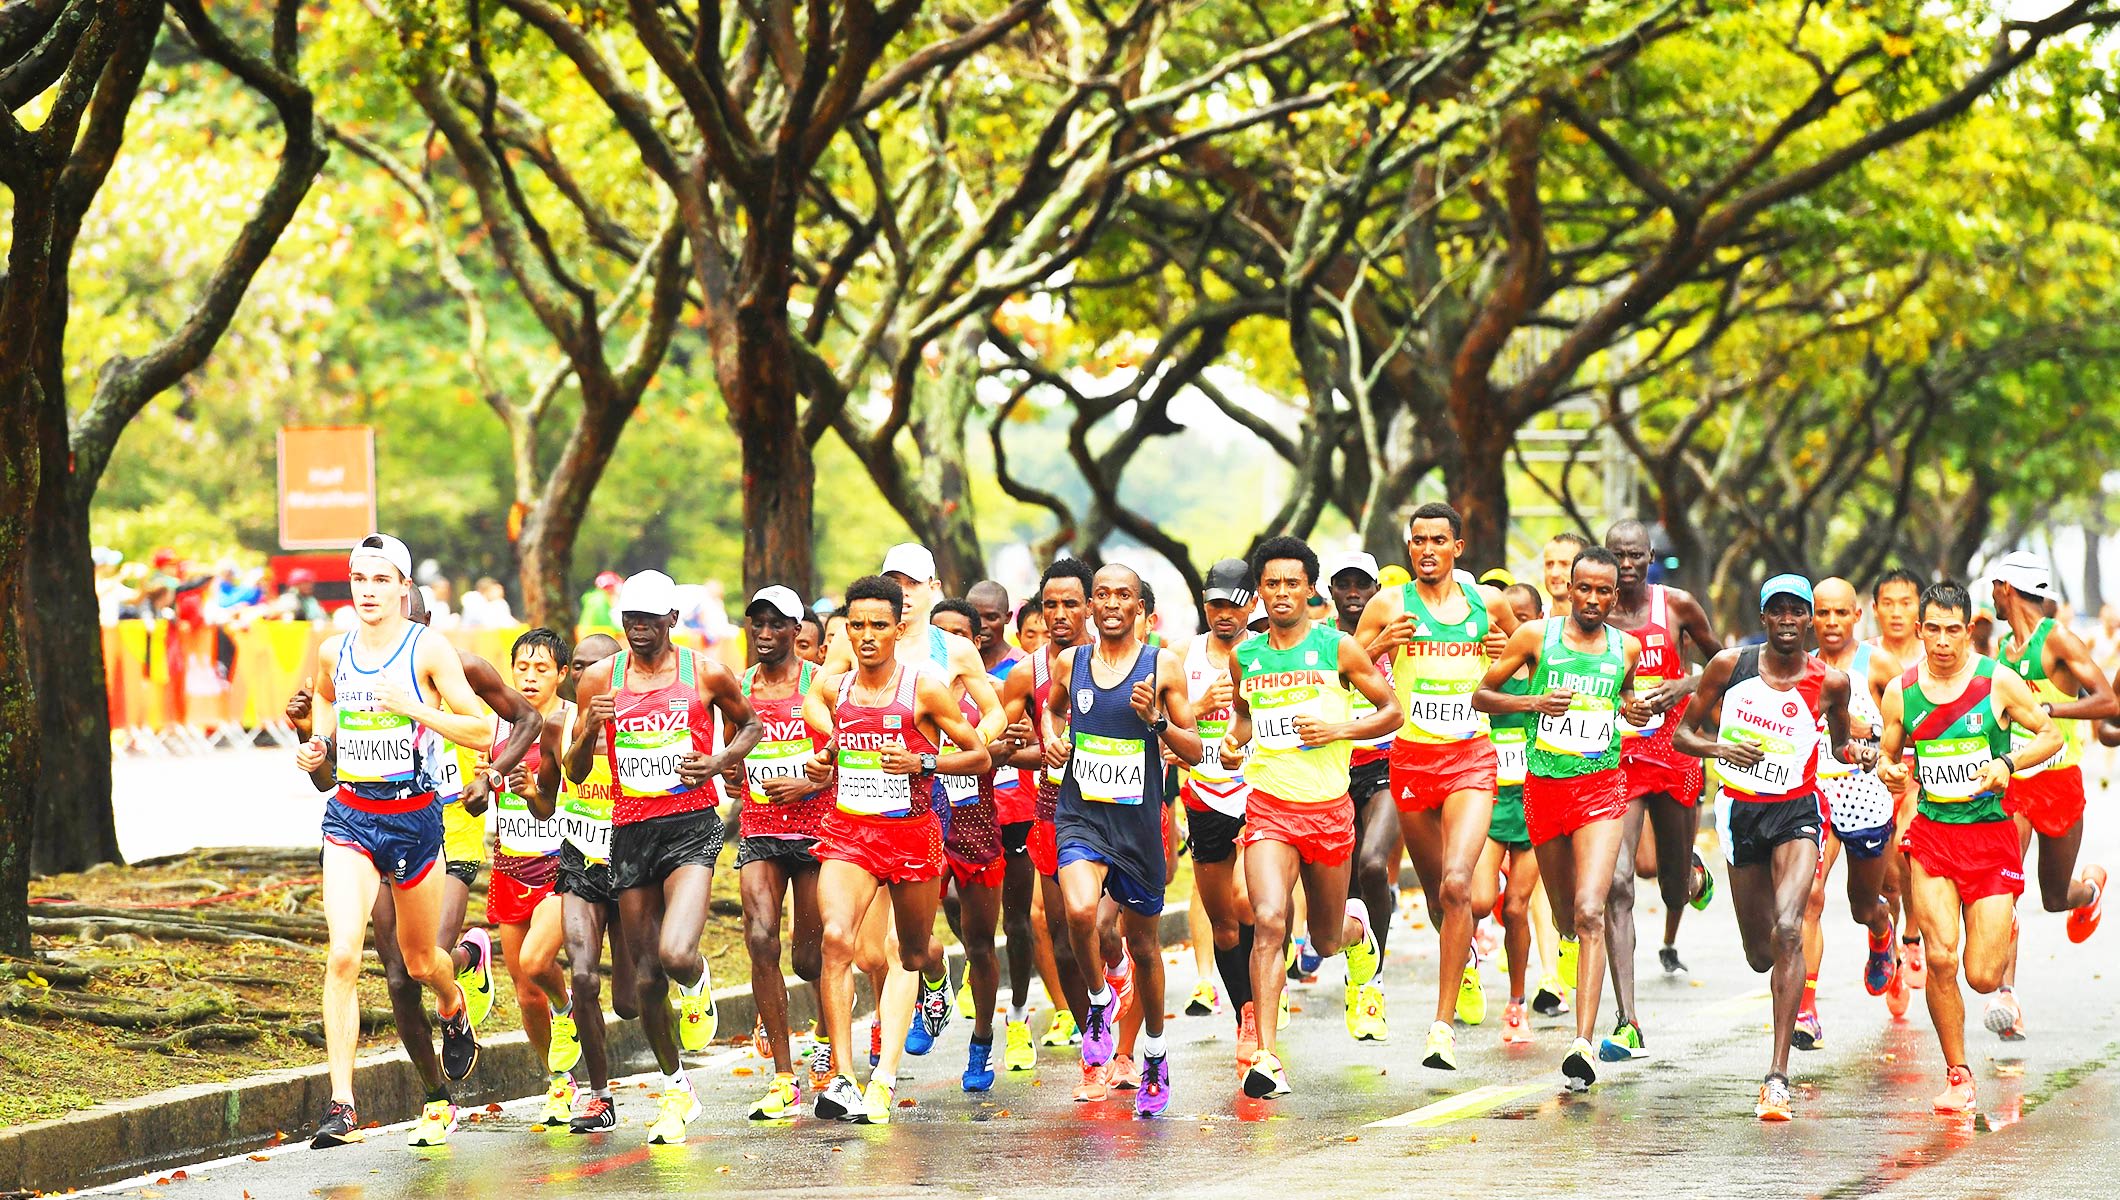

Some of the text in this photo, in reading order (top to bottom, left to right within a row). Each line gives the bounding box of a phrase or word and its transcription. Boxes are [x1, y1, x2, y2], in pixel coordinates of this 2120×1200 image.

[1407, 641, 1483, 657] ETHIOPIA
[1638, 649, 1662, 668] AIN
[1246, 670, 1325, 692] ETHIOPIA
[1548, 670, 1615, 698] DJIBOUTI
[614, 711, 689, 733] KENYA
[1412, 701, 1479, 722] ABERA
[760, 719, 807, 742] ENYA
[1541, 713, 1610, 741] GALA
[339, 738, 411, 761] HAWKINS
[838, 732, 909, 750] ERITREA
[1074, 758, 1142, 785] NKOKA
[567, 818, 611, 845] MUT
